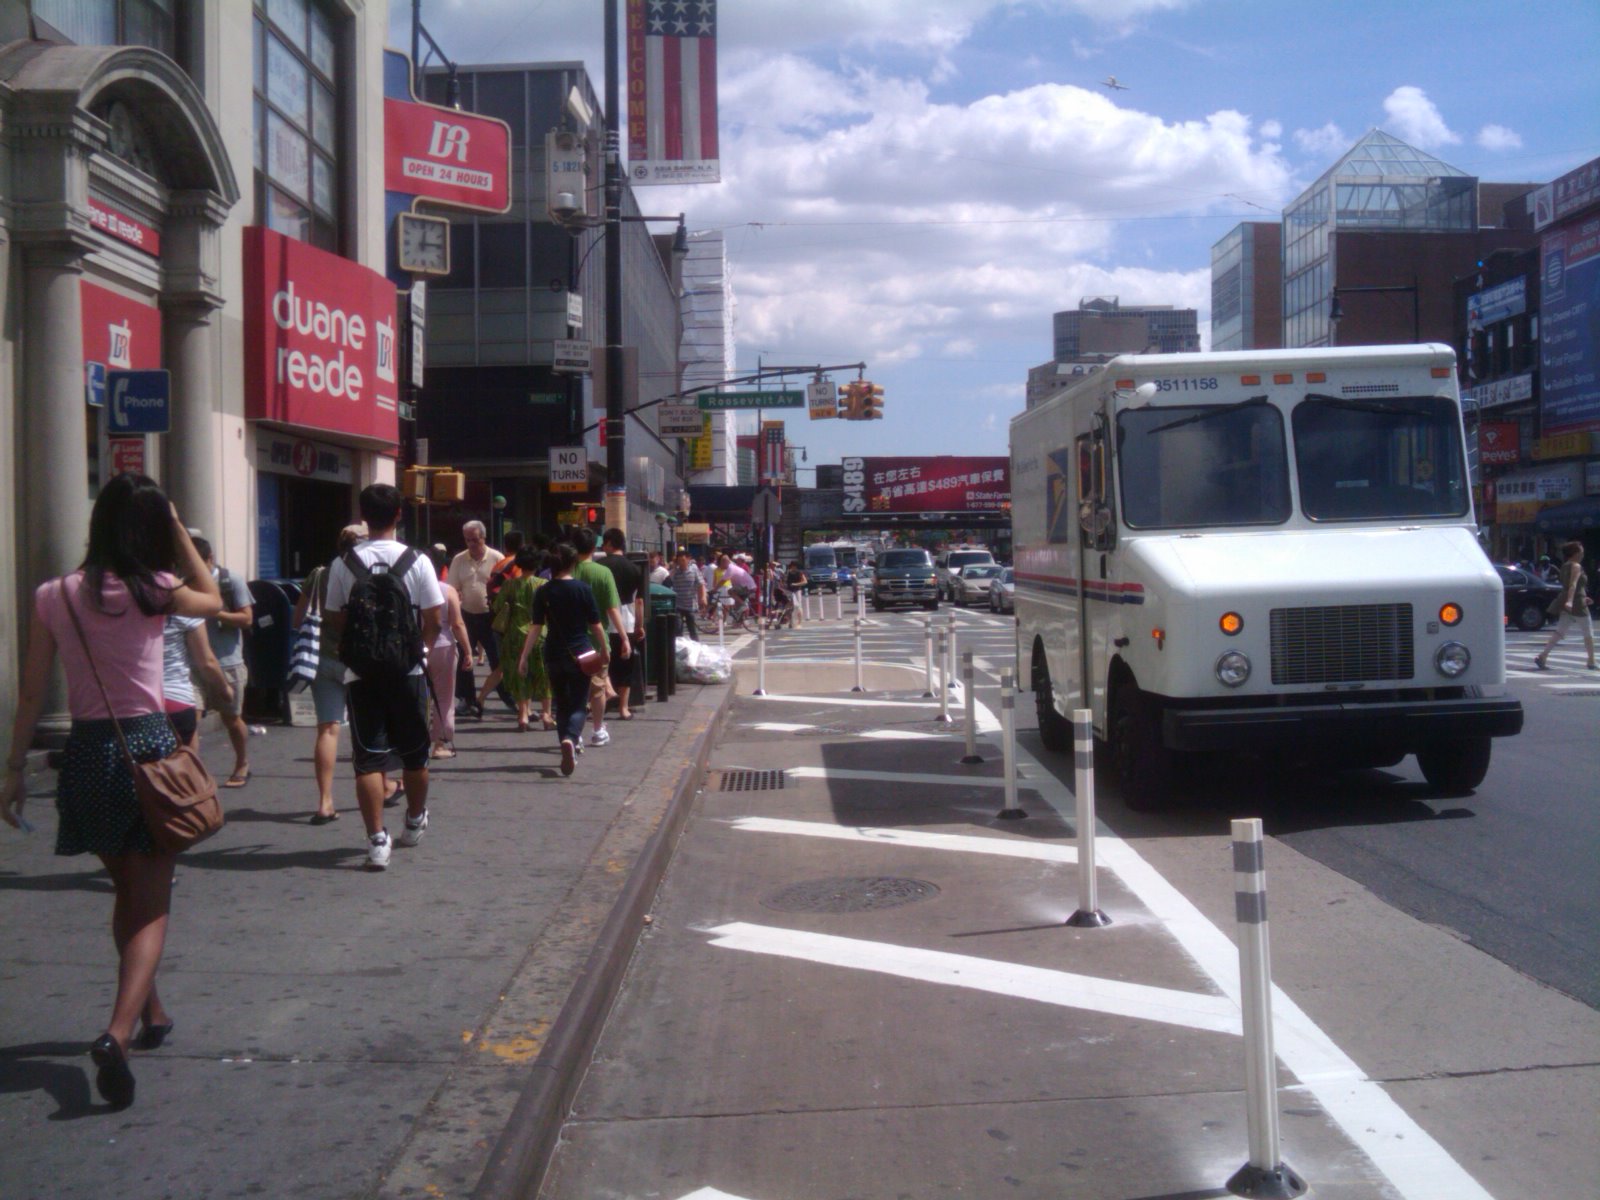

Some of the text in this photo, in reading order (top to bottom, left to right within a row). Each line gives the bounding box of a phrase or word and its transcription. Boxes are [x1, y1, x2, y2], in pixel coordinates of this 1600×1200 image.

[408, 162, 489, 187] OPEN 24 HOURS
[272, 280, 366, 350] duane
[278, 346, 363, 400] reade
[815, 387, 827, 396] NO
[1154, 378, 1218, 392] 3511158
[125, 396, 164, 408] Phone
[708, 395, 793, 407] Roosevelt Av
[559, 452, 577, 464] NO
[552, 469, 585, 480] TURNS
[843, 457, 866, 512] $489
